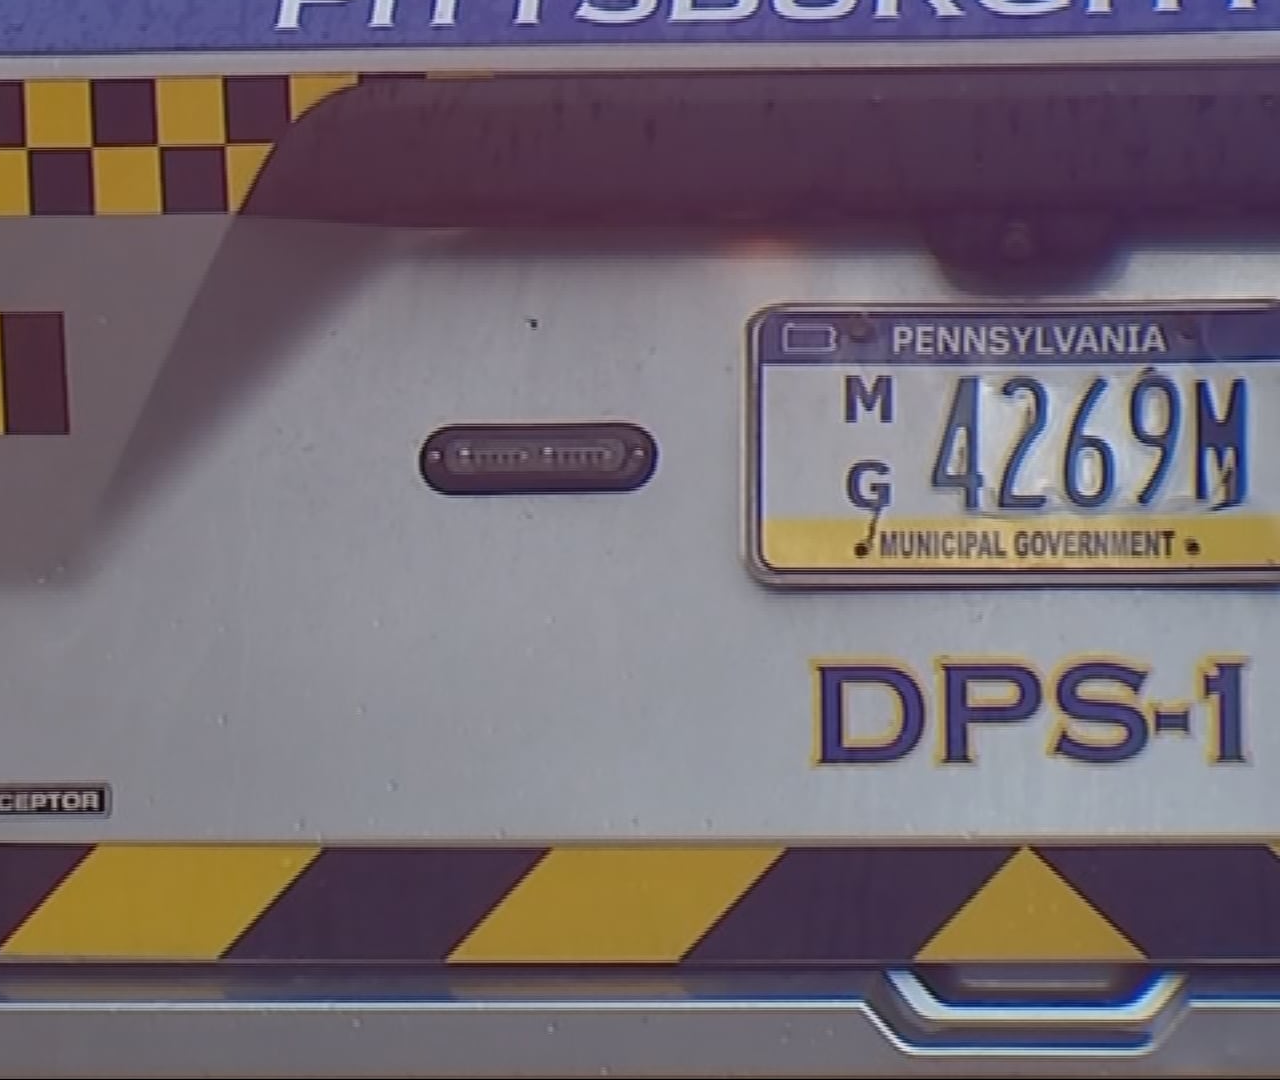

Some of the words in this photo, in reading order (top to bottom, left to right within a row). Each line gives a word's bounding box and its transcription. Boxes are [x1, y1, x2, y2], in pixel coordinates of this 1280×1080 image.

[892, 324, 1167, 354] PENNSYLVANIA
[844, 375, 893, 423] M
[932, 375, 1248, 510] 4269M
[880, 531, 1006, 559] MUNICIPAL
[1014, 531, 1176, 558] GOVERNMENT
[811, 656, 1252, 766] DPS-1
